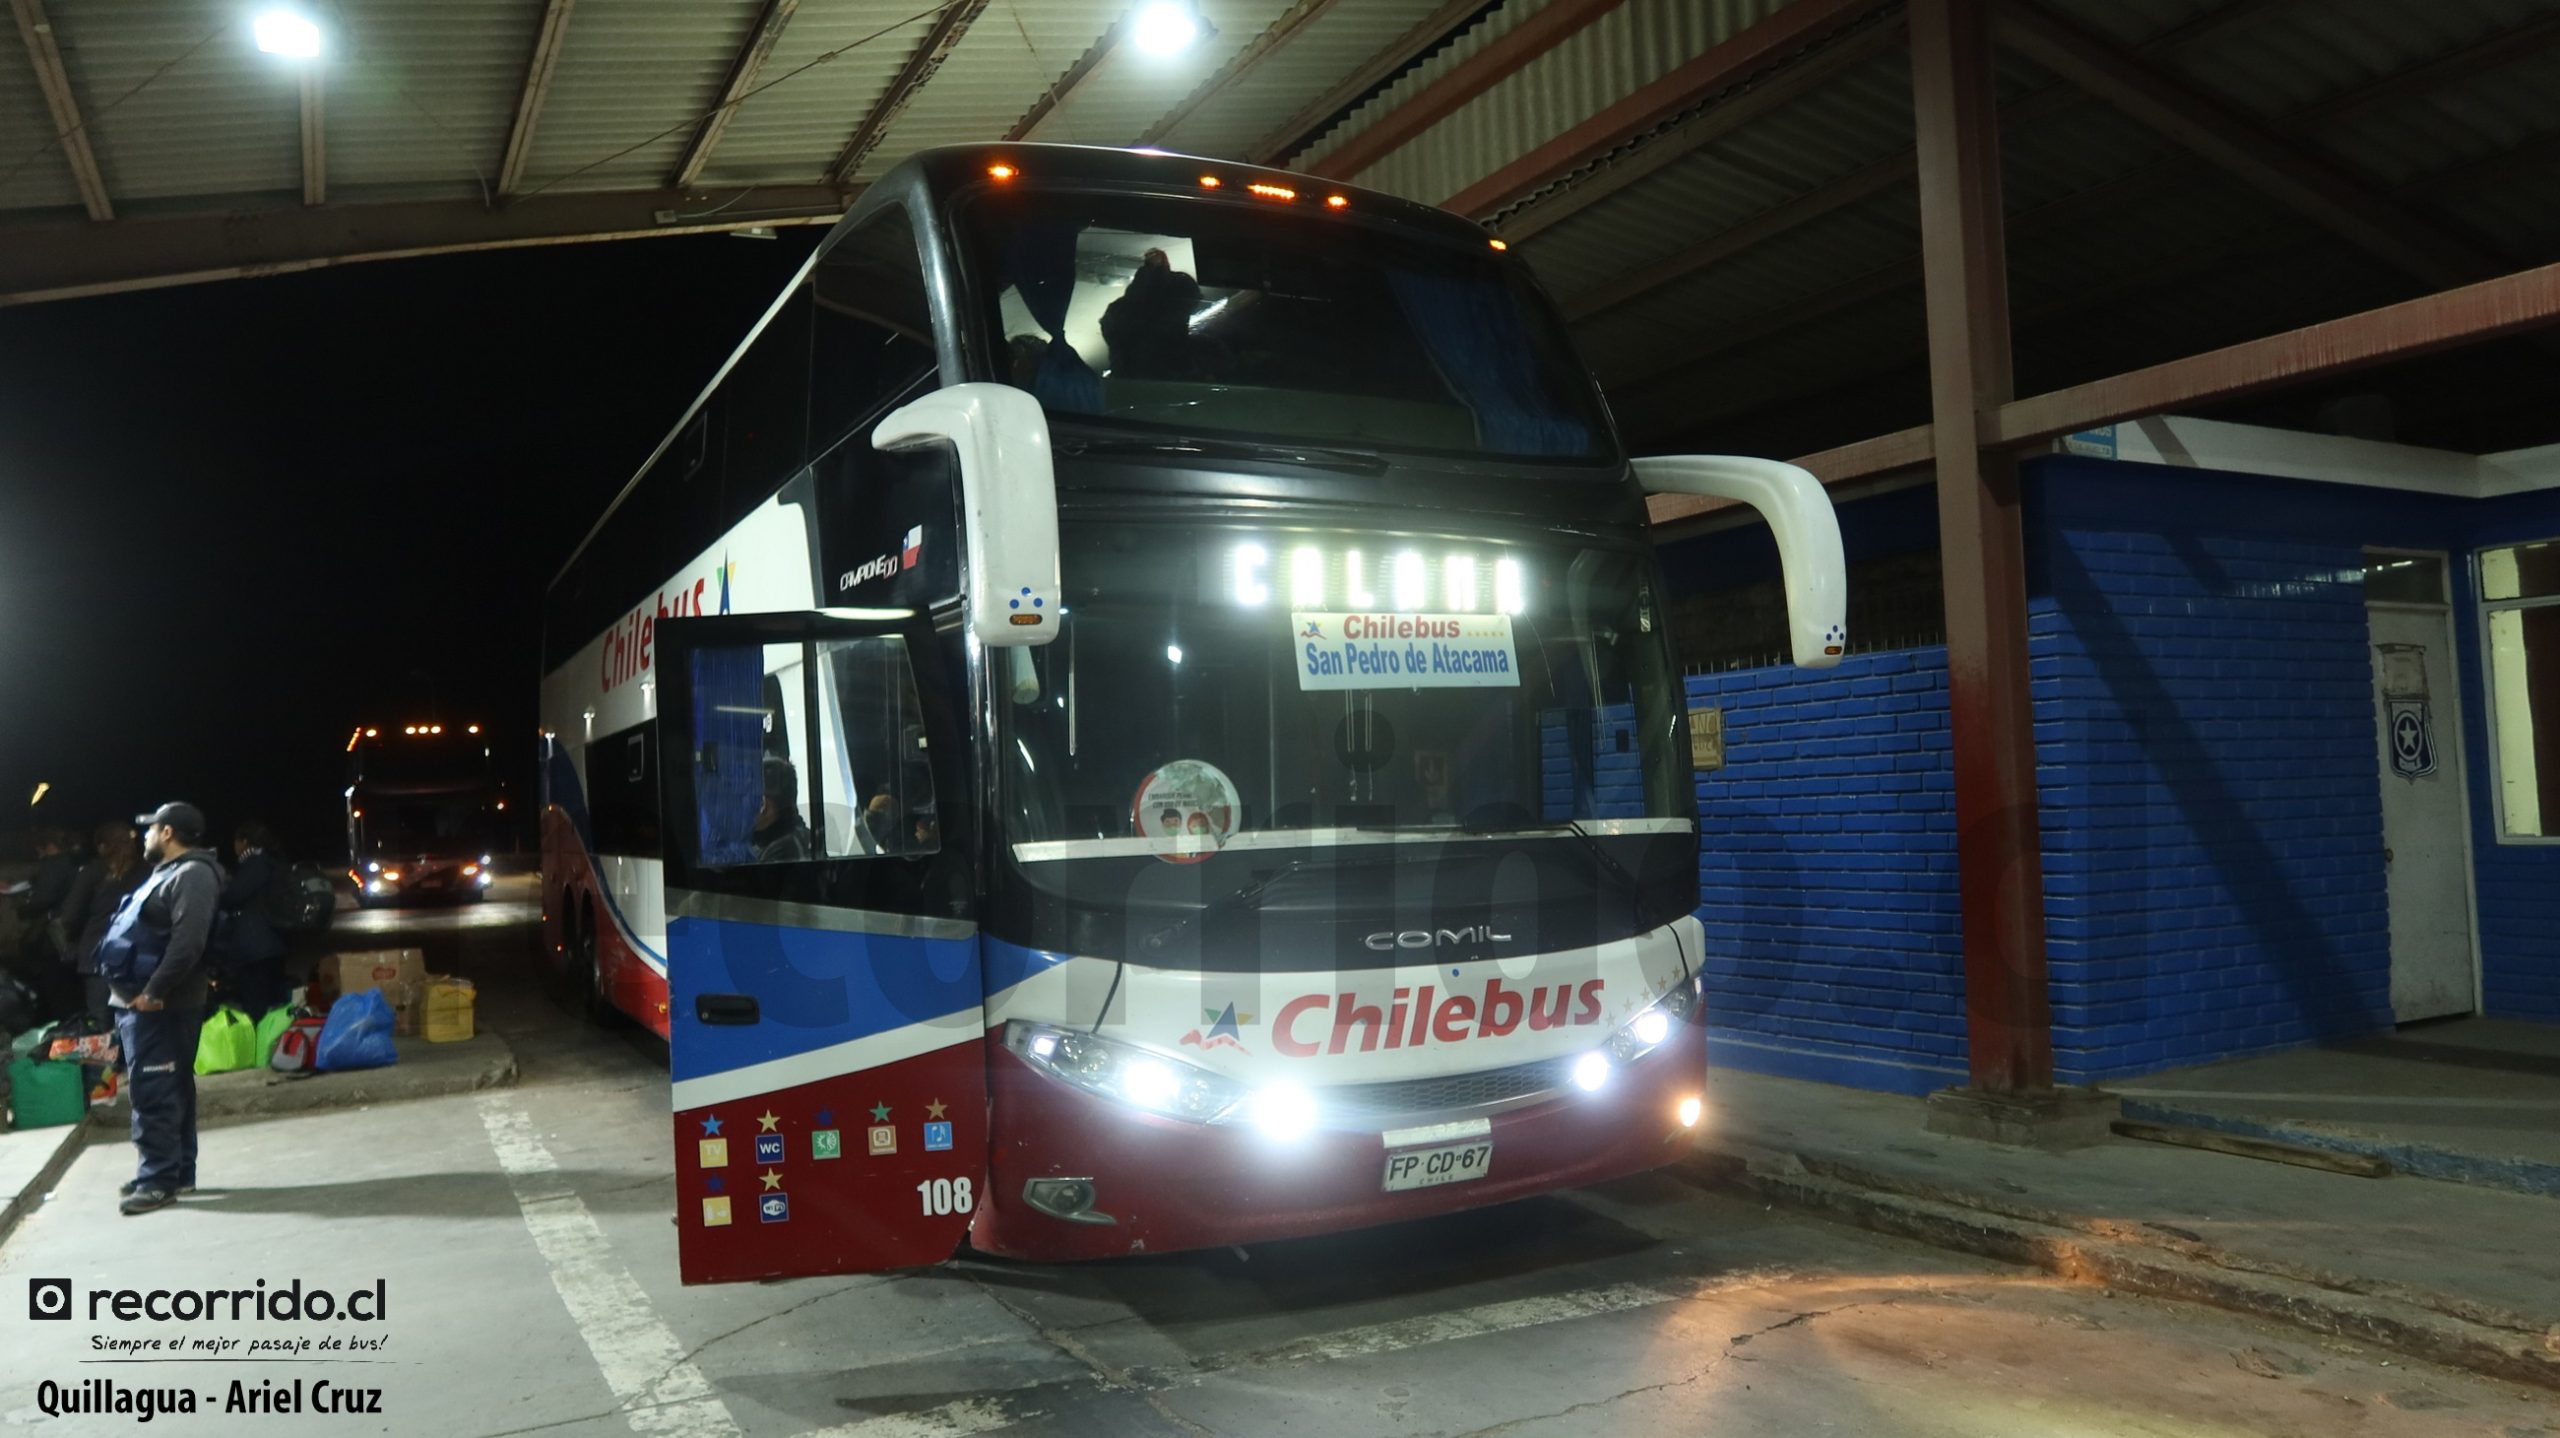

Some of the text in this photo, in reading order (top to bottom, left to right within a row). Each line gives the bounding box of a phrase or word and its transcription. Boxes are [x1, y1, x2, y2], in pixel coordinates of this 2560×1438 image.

[1343, 615, 1460, 639] Chilebus
[1306, 642, 1509, 675] San Pedro de Atacama
[1365, 925, 1511, 950] COMIL
[1272, 978, 1604, 1057] Chilebus
[760, 1143, 781, 1154] WC
[917, 1177, 972, 1216] 108
